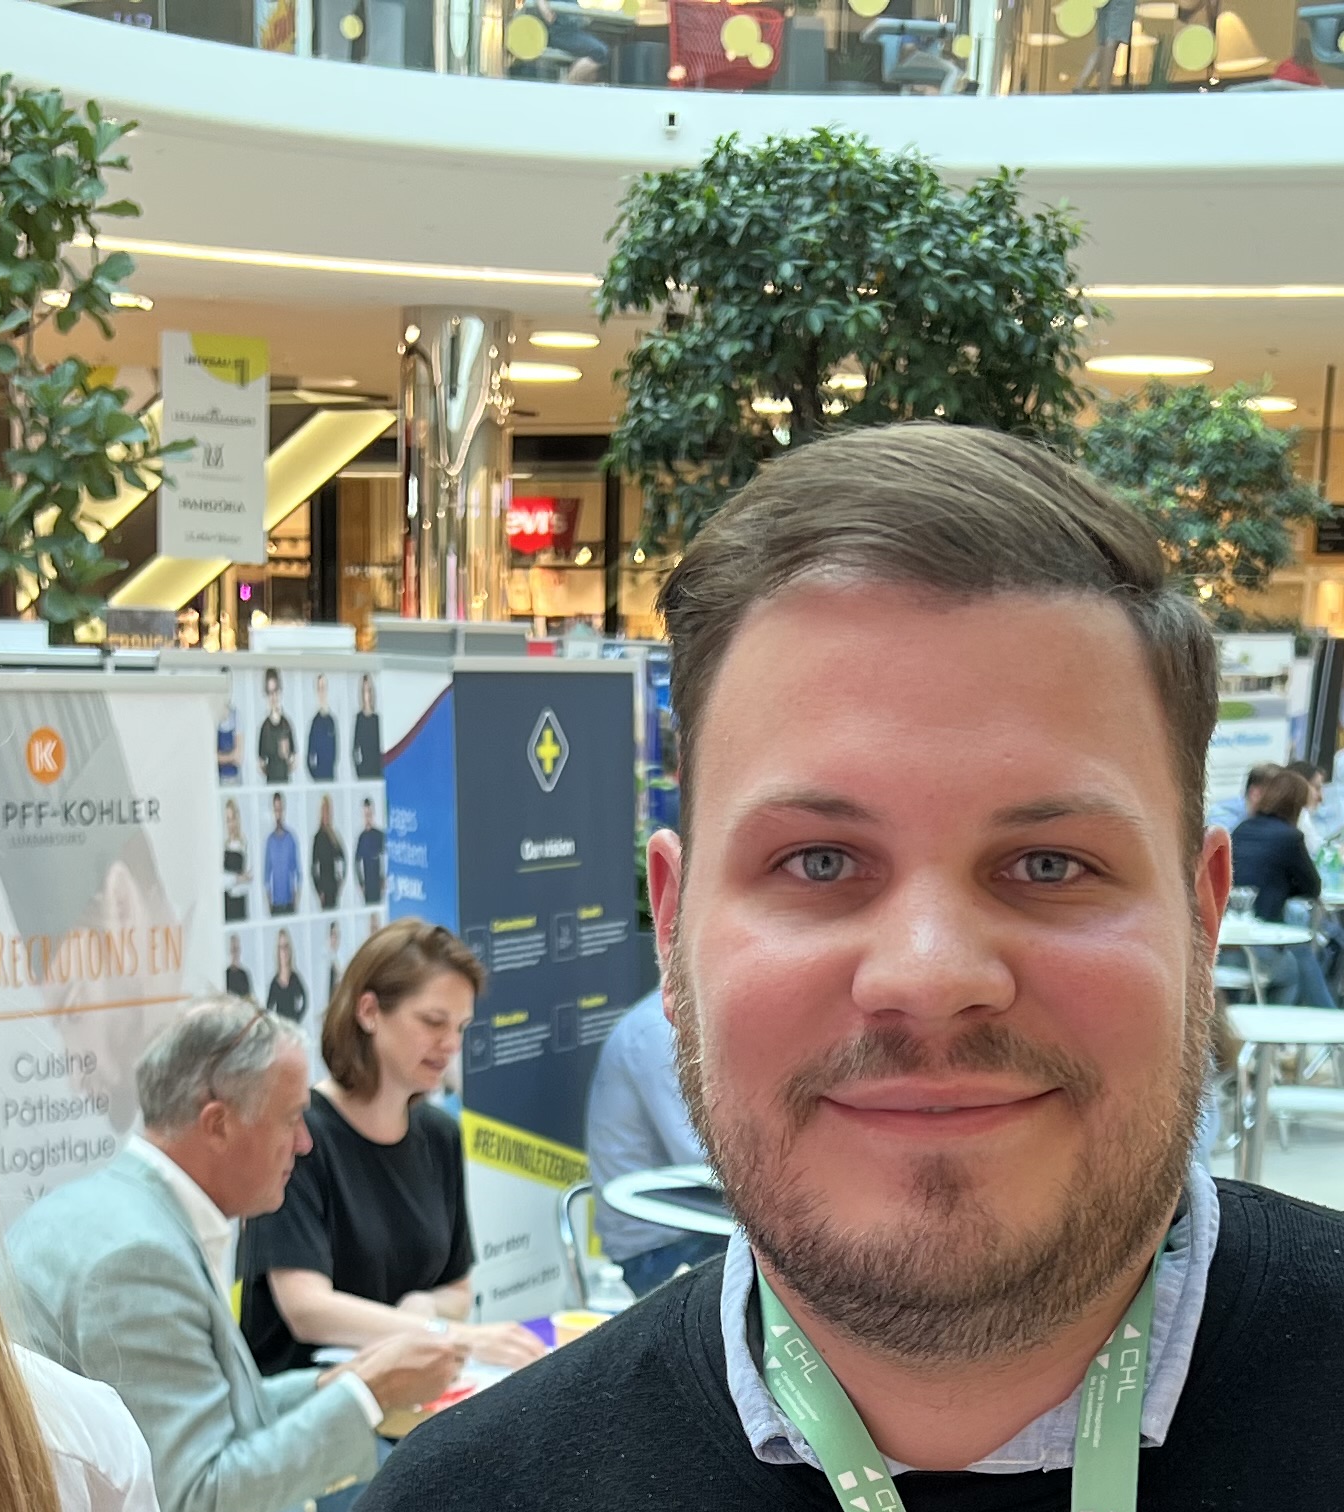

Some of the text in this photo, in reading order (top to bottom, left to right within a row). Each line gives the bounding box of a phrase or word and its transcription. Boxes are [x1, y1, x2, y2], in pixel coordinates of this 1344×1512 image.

[149, 924, 183, 976] EN
[13, 1048, 98, 1084] Cuisine
[3, 1089, 110, 1129] Pâtisserie
[0, 1133, 116, 1177] Logistique
[784, 1338, 819, 1384] CHL
[1116, 1348, 1140, 1403] CHL
